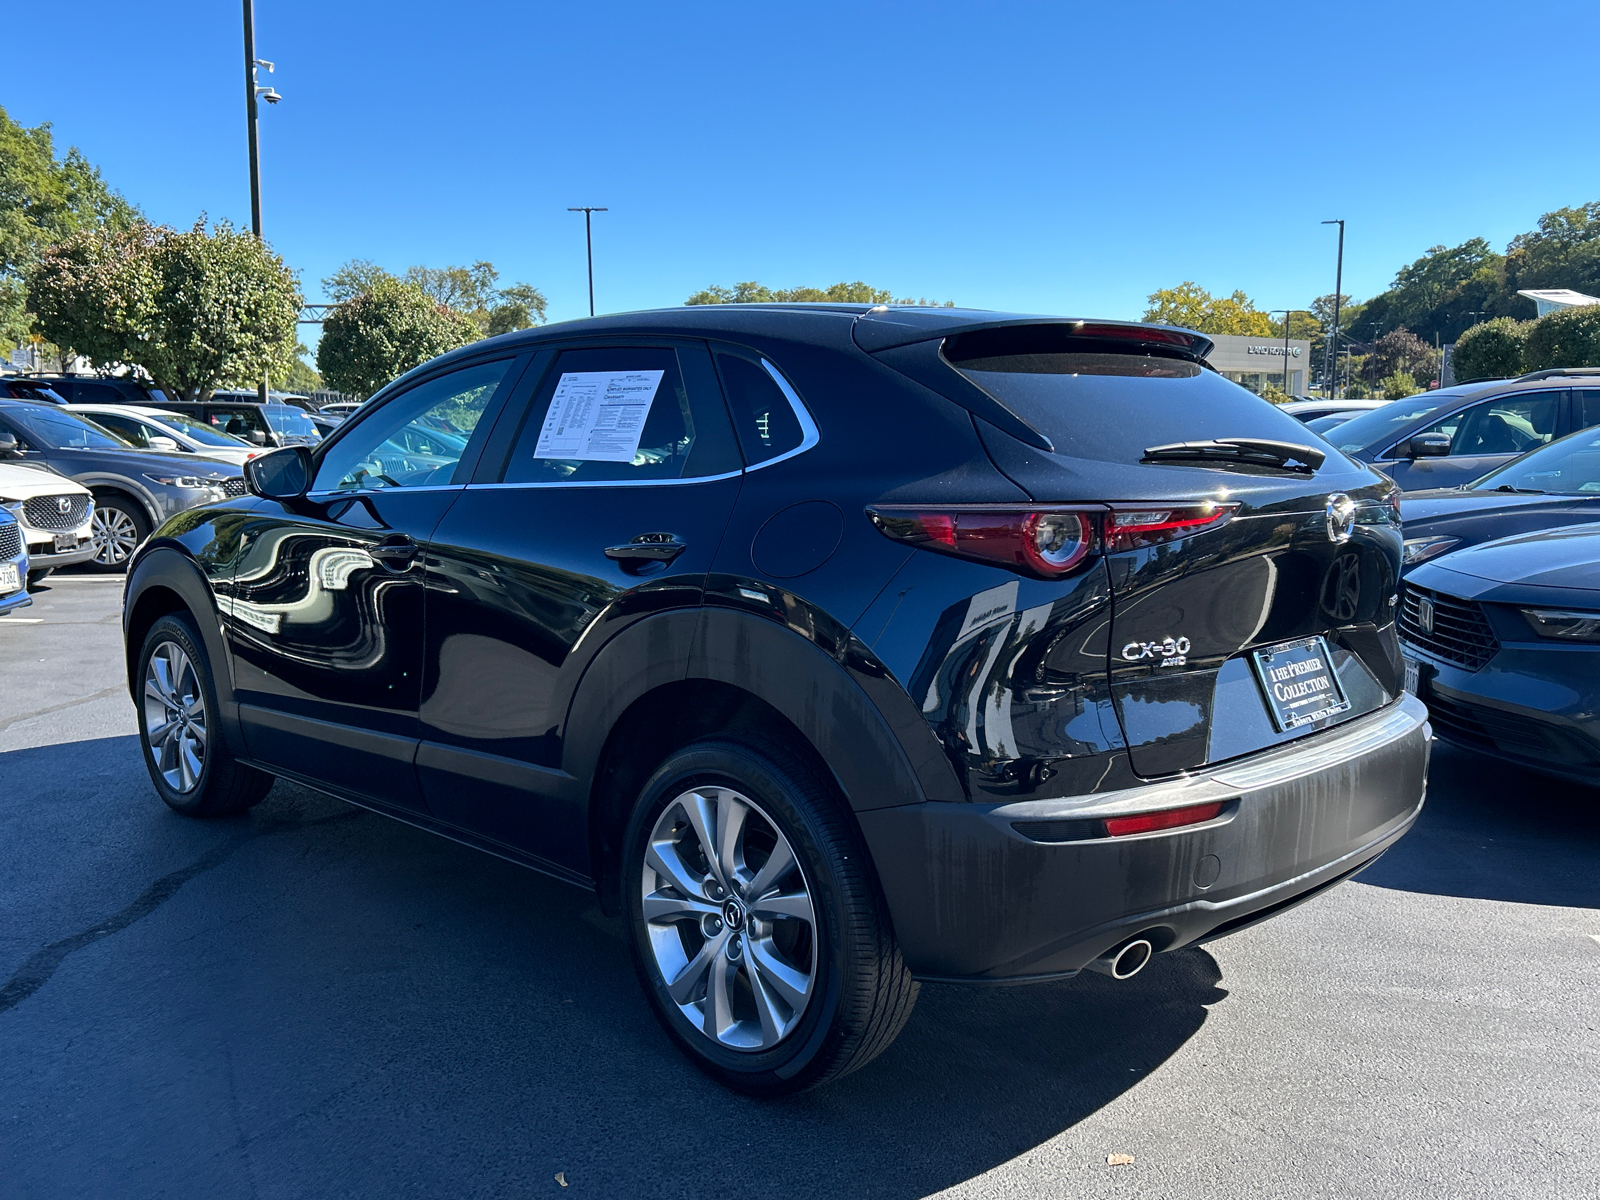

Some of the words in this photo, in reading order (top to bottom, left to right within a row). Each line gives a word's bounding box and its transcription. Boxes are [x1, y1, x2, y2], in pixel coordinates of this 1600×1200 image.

[1248, 345, 1268, 354] LAND
[162, 621, 202, 666] BRIDGESTONE
[1122, 636, 1191, 660] CX-30
[1160, 655, 1187, 668] AWD
[1286, 657, 1323, 678] PREMIER
[1274, 675, 1330, 702] COLLECTION
